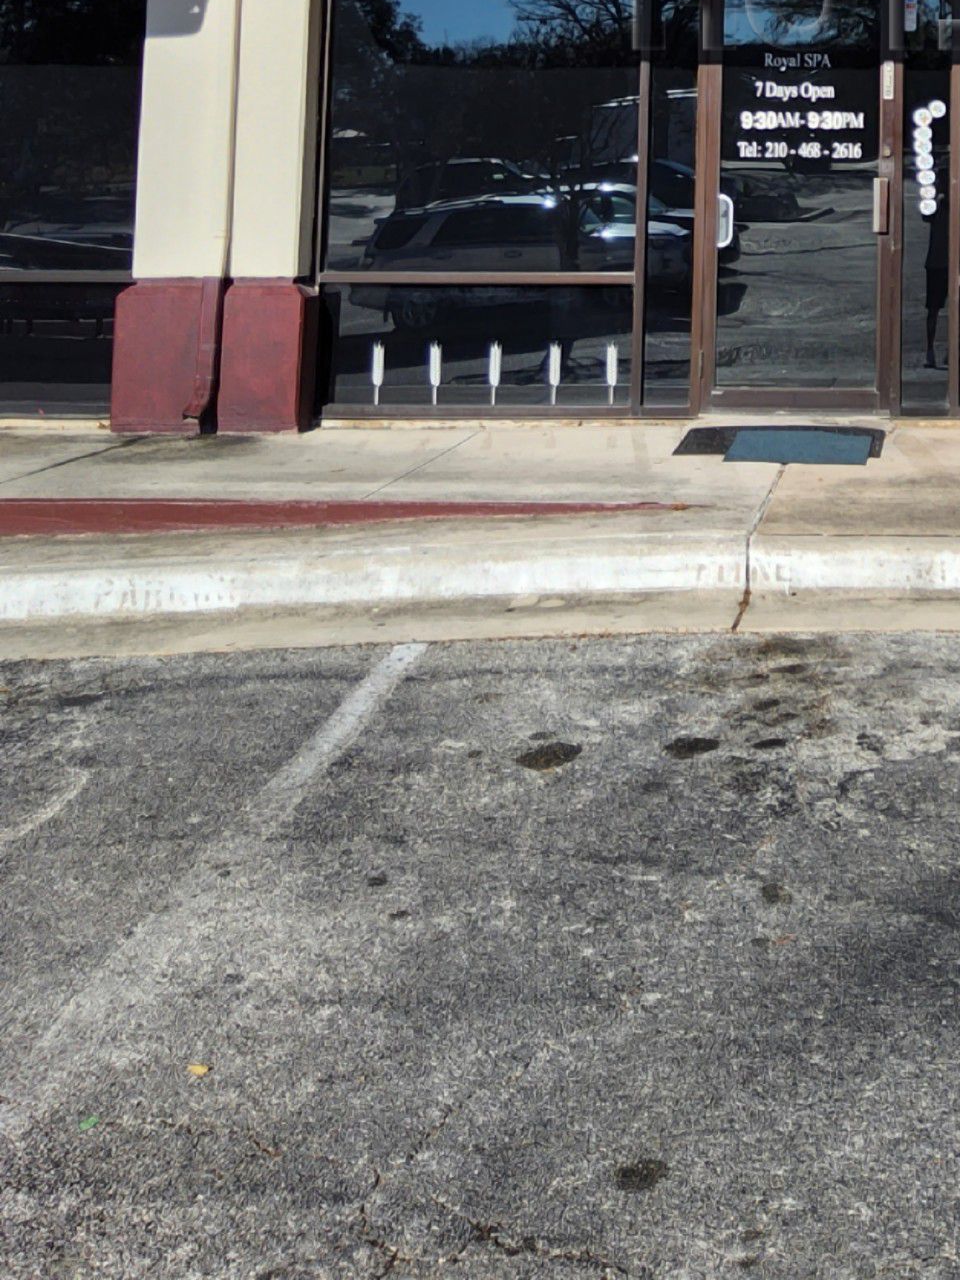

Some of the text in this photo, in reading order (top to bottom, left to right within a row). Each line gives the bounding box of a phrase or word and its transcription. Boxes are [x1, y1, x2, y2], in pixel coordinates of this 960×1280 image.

[764, 52, 832, 71] Royal SPA
[755, 82, 835, 102] 7 Days Open
[737, 141, 762, 158] Tel:
[765, 141, 788, 158] 210
[798, 141, 821, 158] 468
[832, 141, 862, 158] 2616
